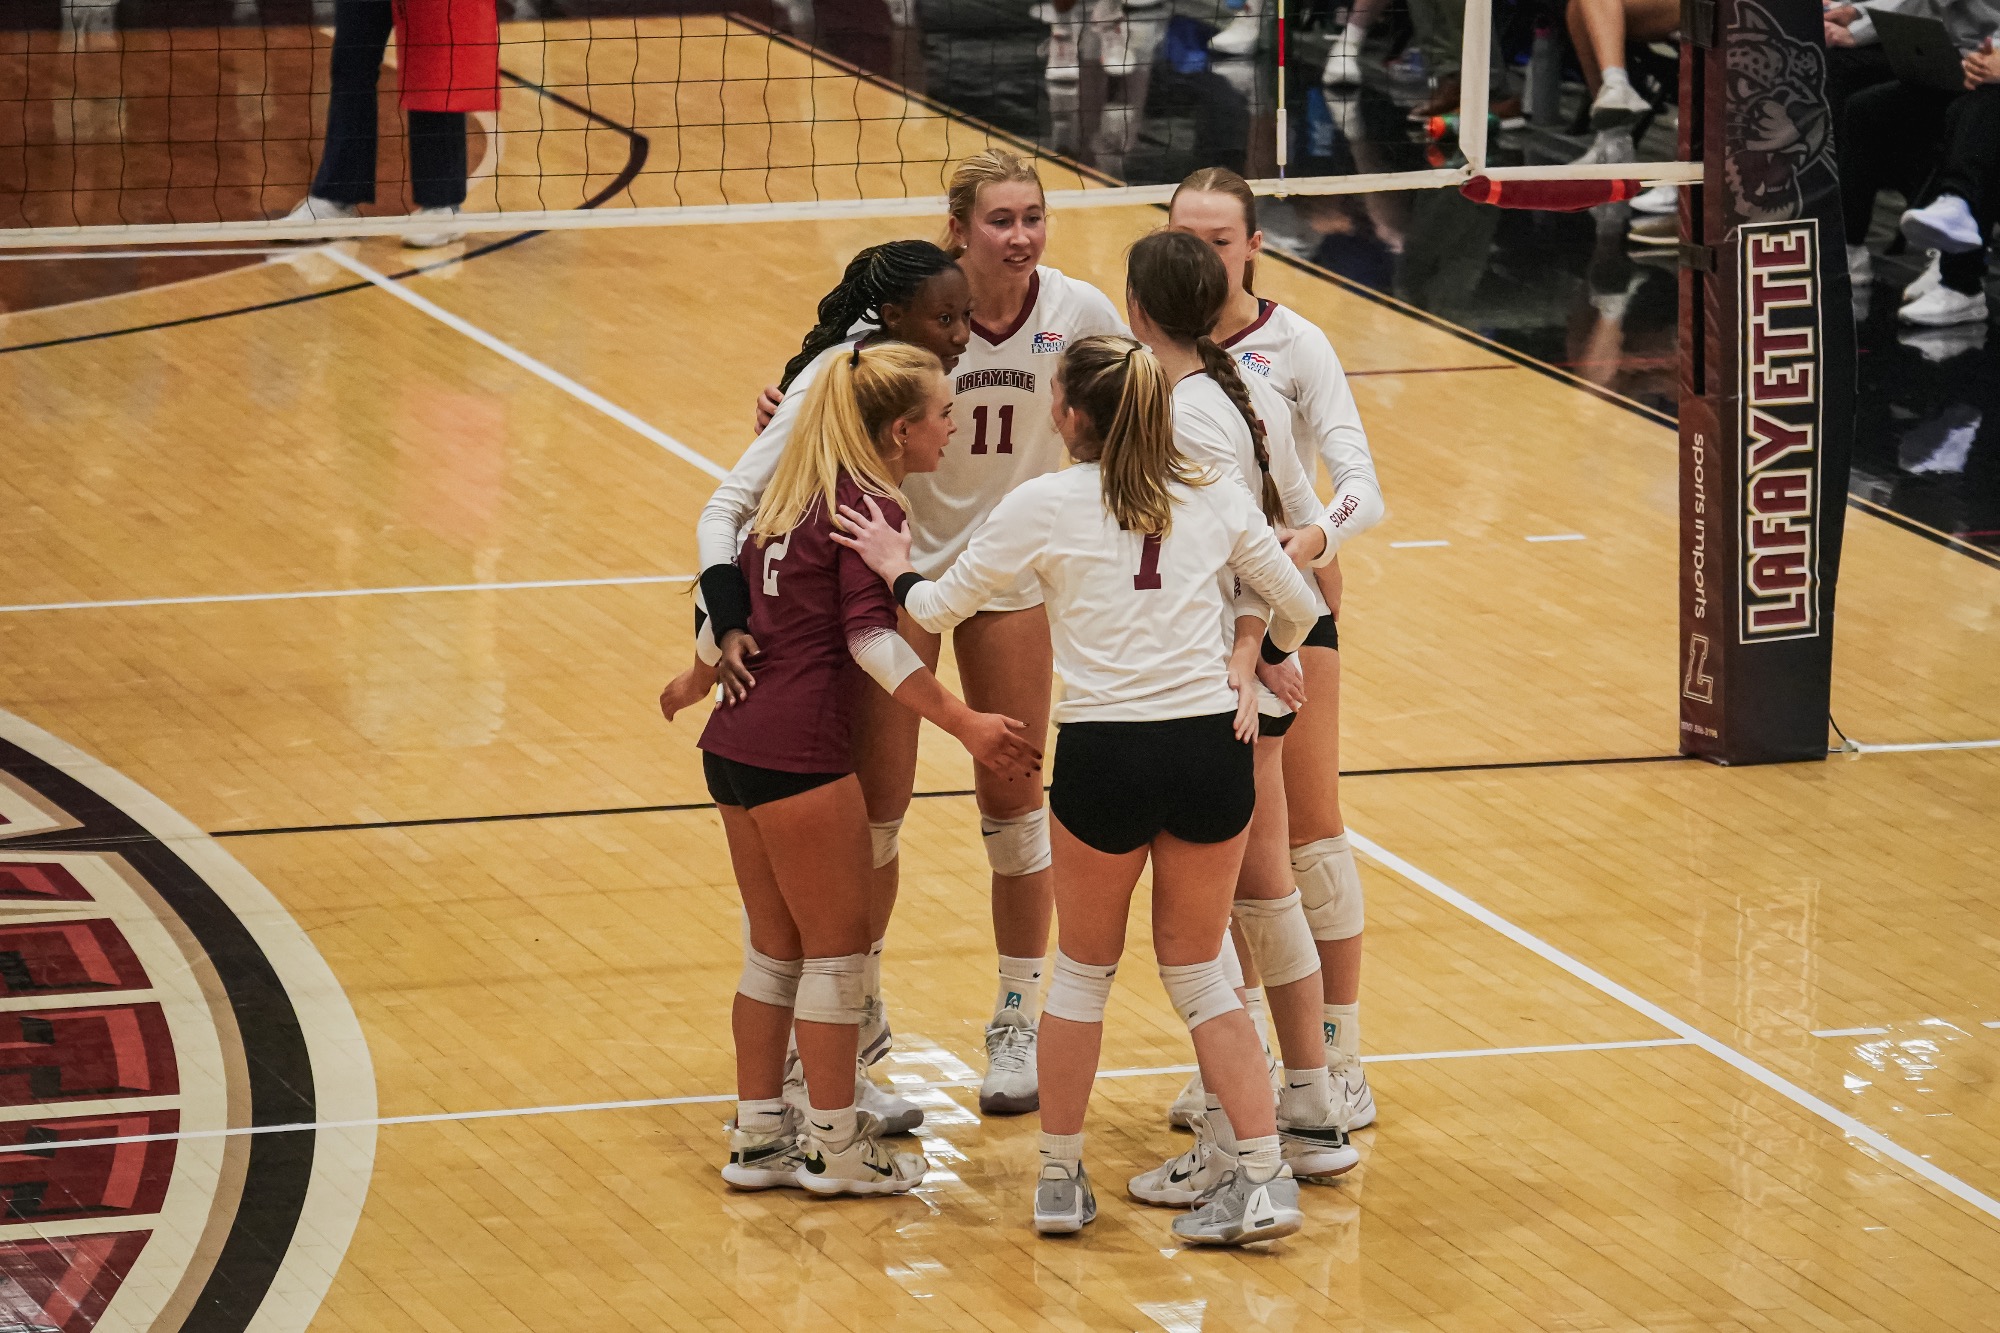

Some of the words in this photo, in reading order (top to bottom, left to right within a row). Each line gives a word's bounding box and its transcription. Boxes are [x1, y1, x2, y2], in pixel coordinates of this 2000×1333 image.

[1031, 341, 1066, 349] PATRIOT
[956, 368, 1035, 395] LAFAYETTE
[971, 405, 1014, 454] 11
[1748, 229, 1815, 633] LAFAYETTE
[1694, 433, 1706, 515] sports
[1693, 517, 1706, 620] imports
